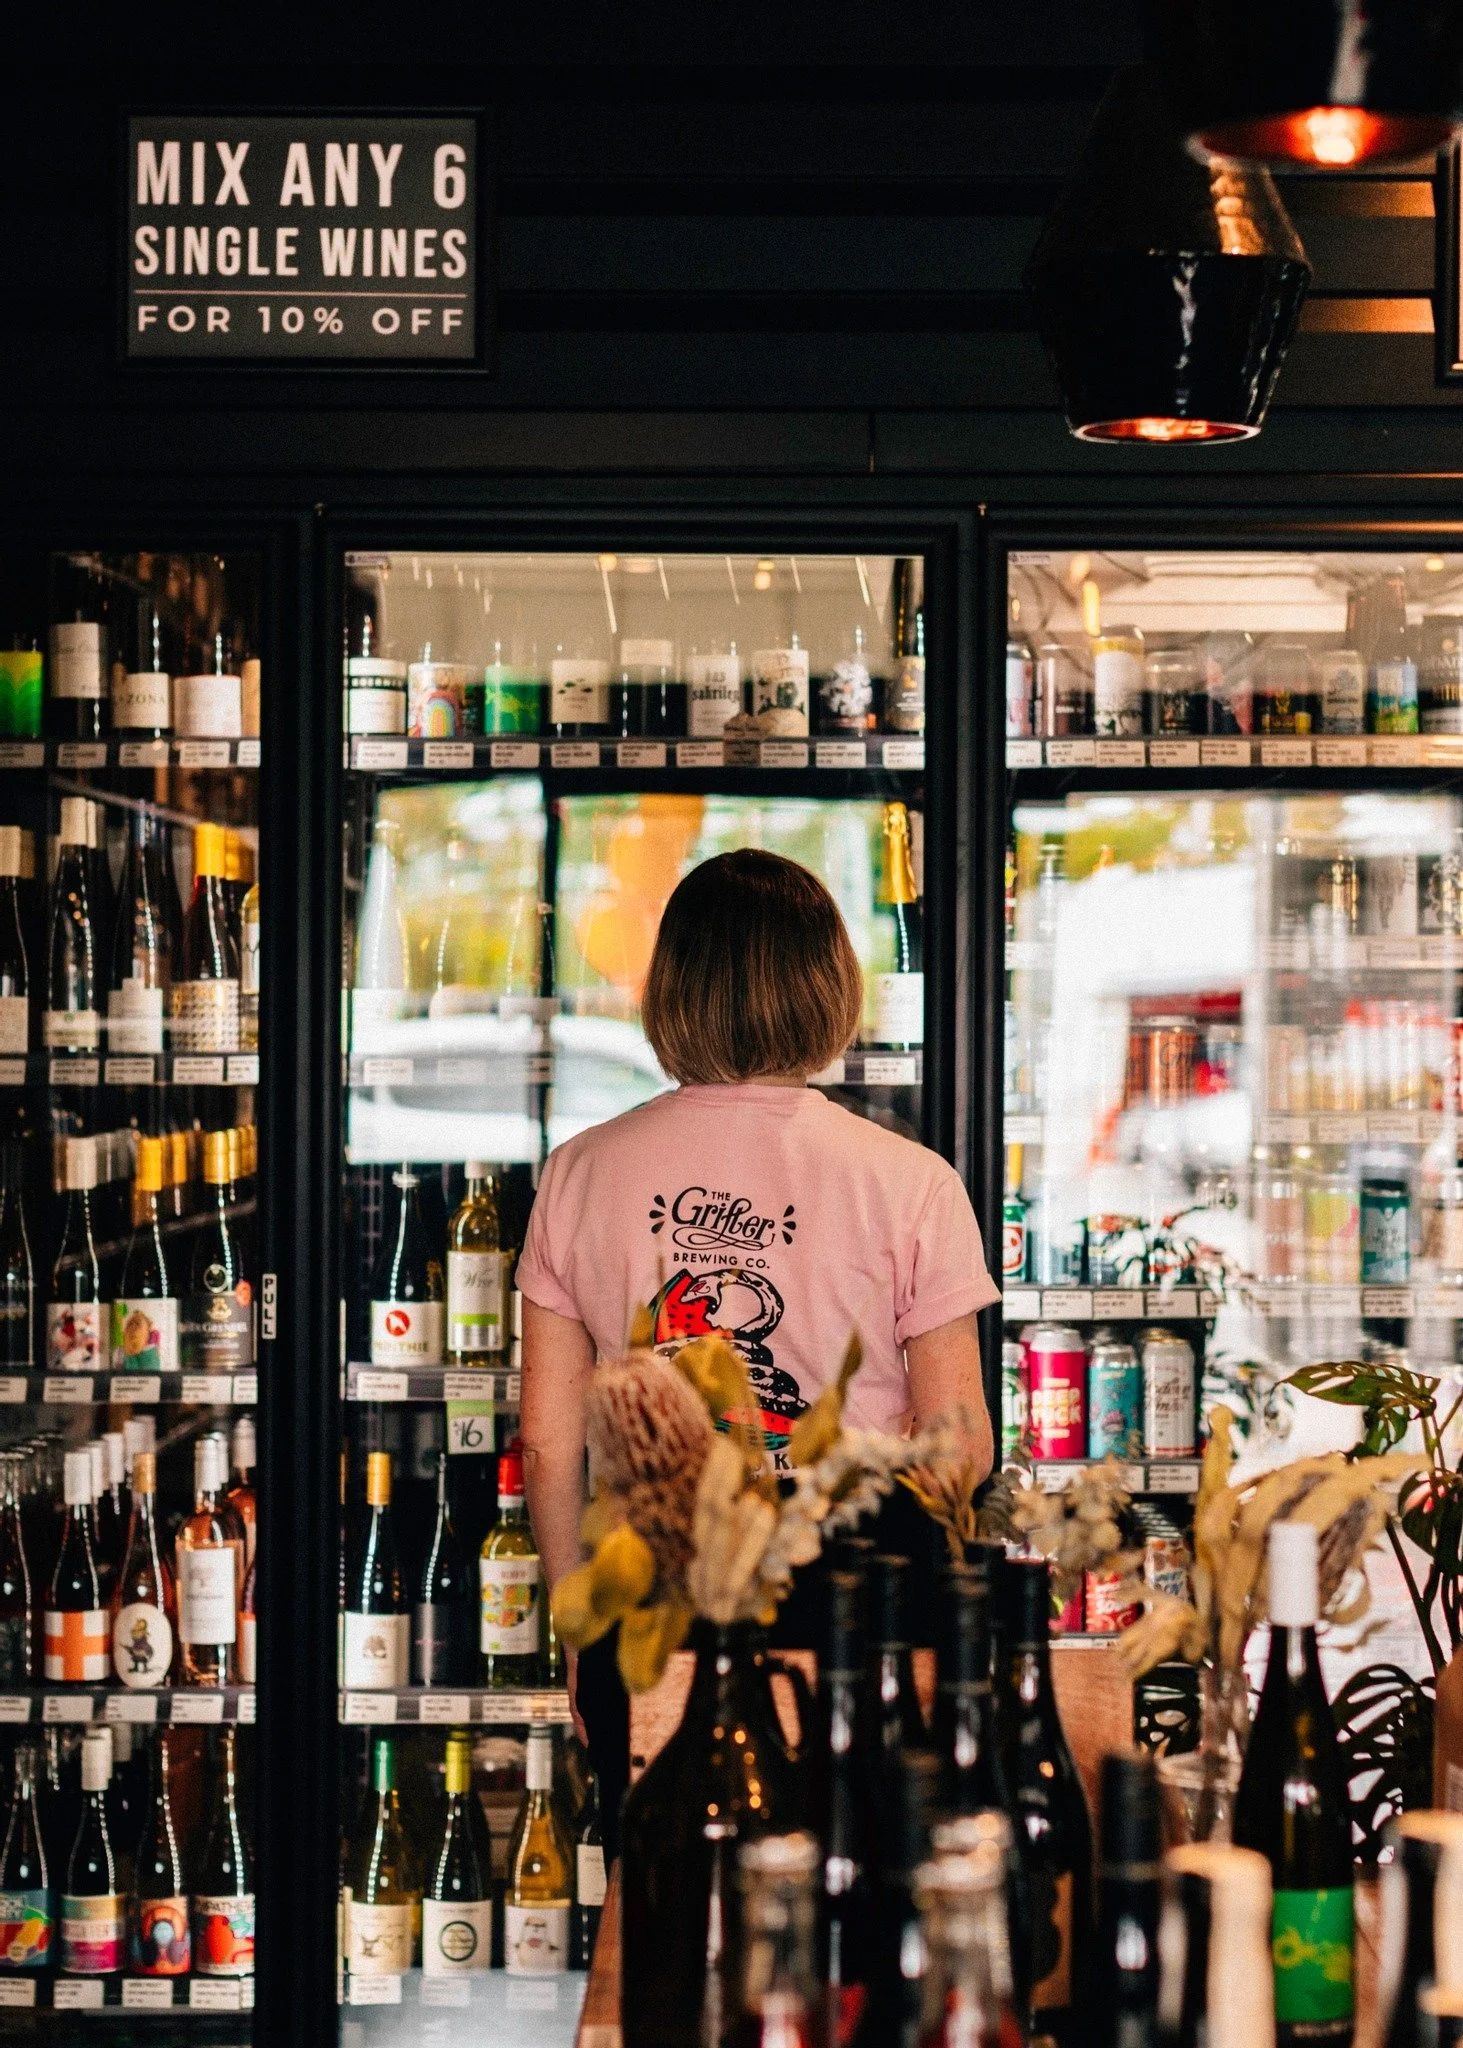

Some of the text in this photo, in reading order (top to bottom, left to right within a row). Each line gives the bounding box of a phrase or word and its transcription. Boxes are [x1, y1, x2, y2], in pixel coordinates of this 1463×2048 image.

[137, 141, 467, 209] MIX ANY 6
[134, 225, 467, 279] SINGLE WINES
[138, 305, 464, 336] FOR 10% OFF
[671, 1186, 776, 1244] Grifter
[711, 1191, 731, 1201] THE
[673, 1252, 770, 1269] BREWING CO.
[264, 1278, 274, 1335] PULL
